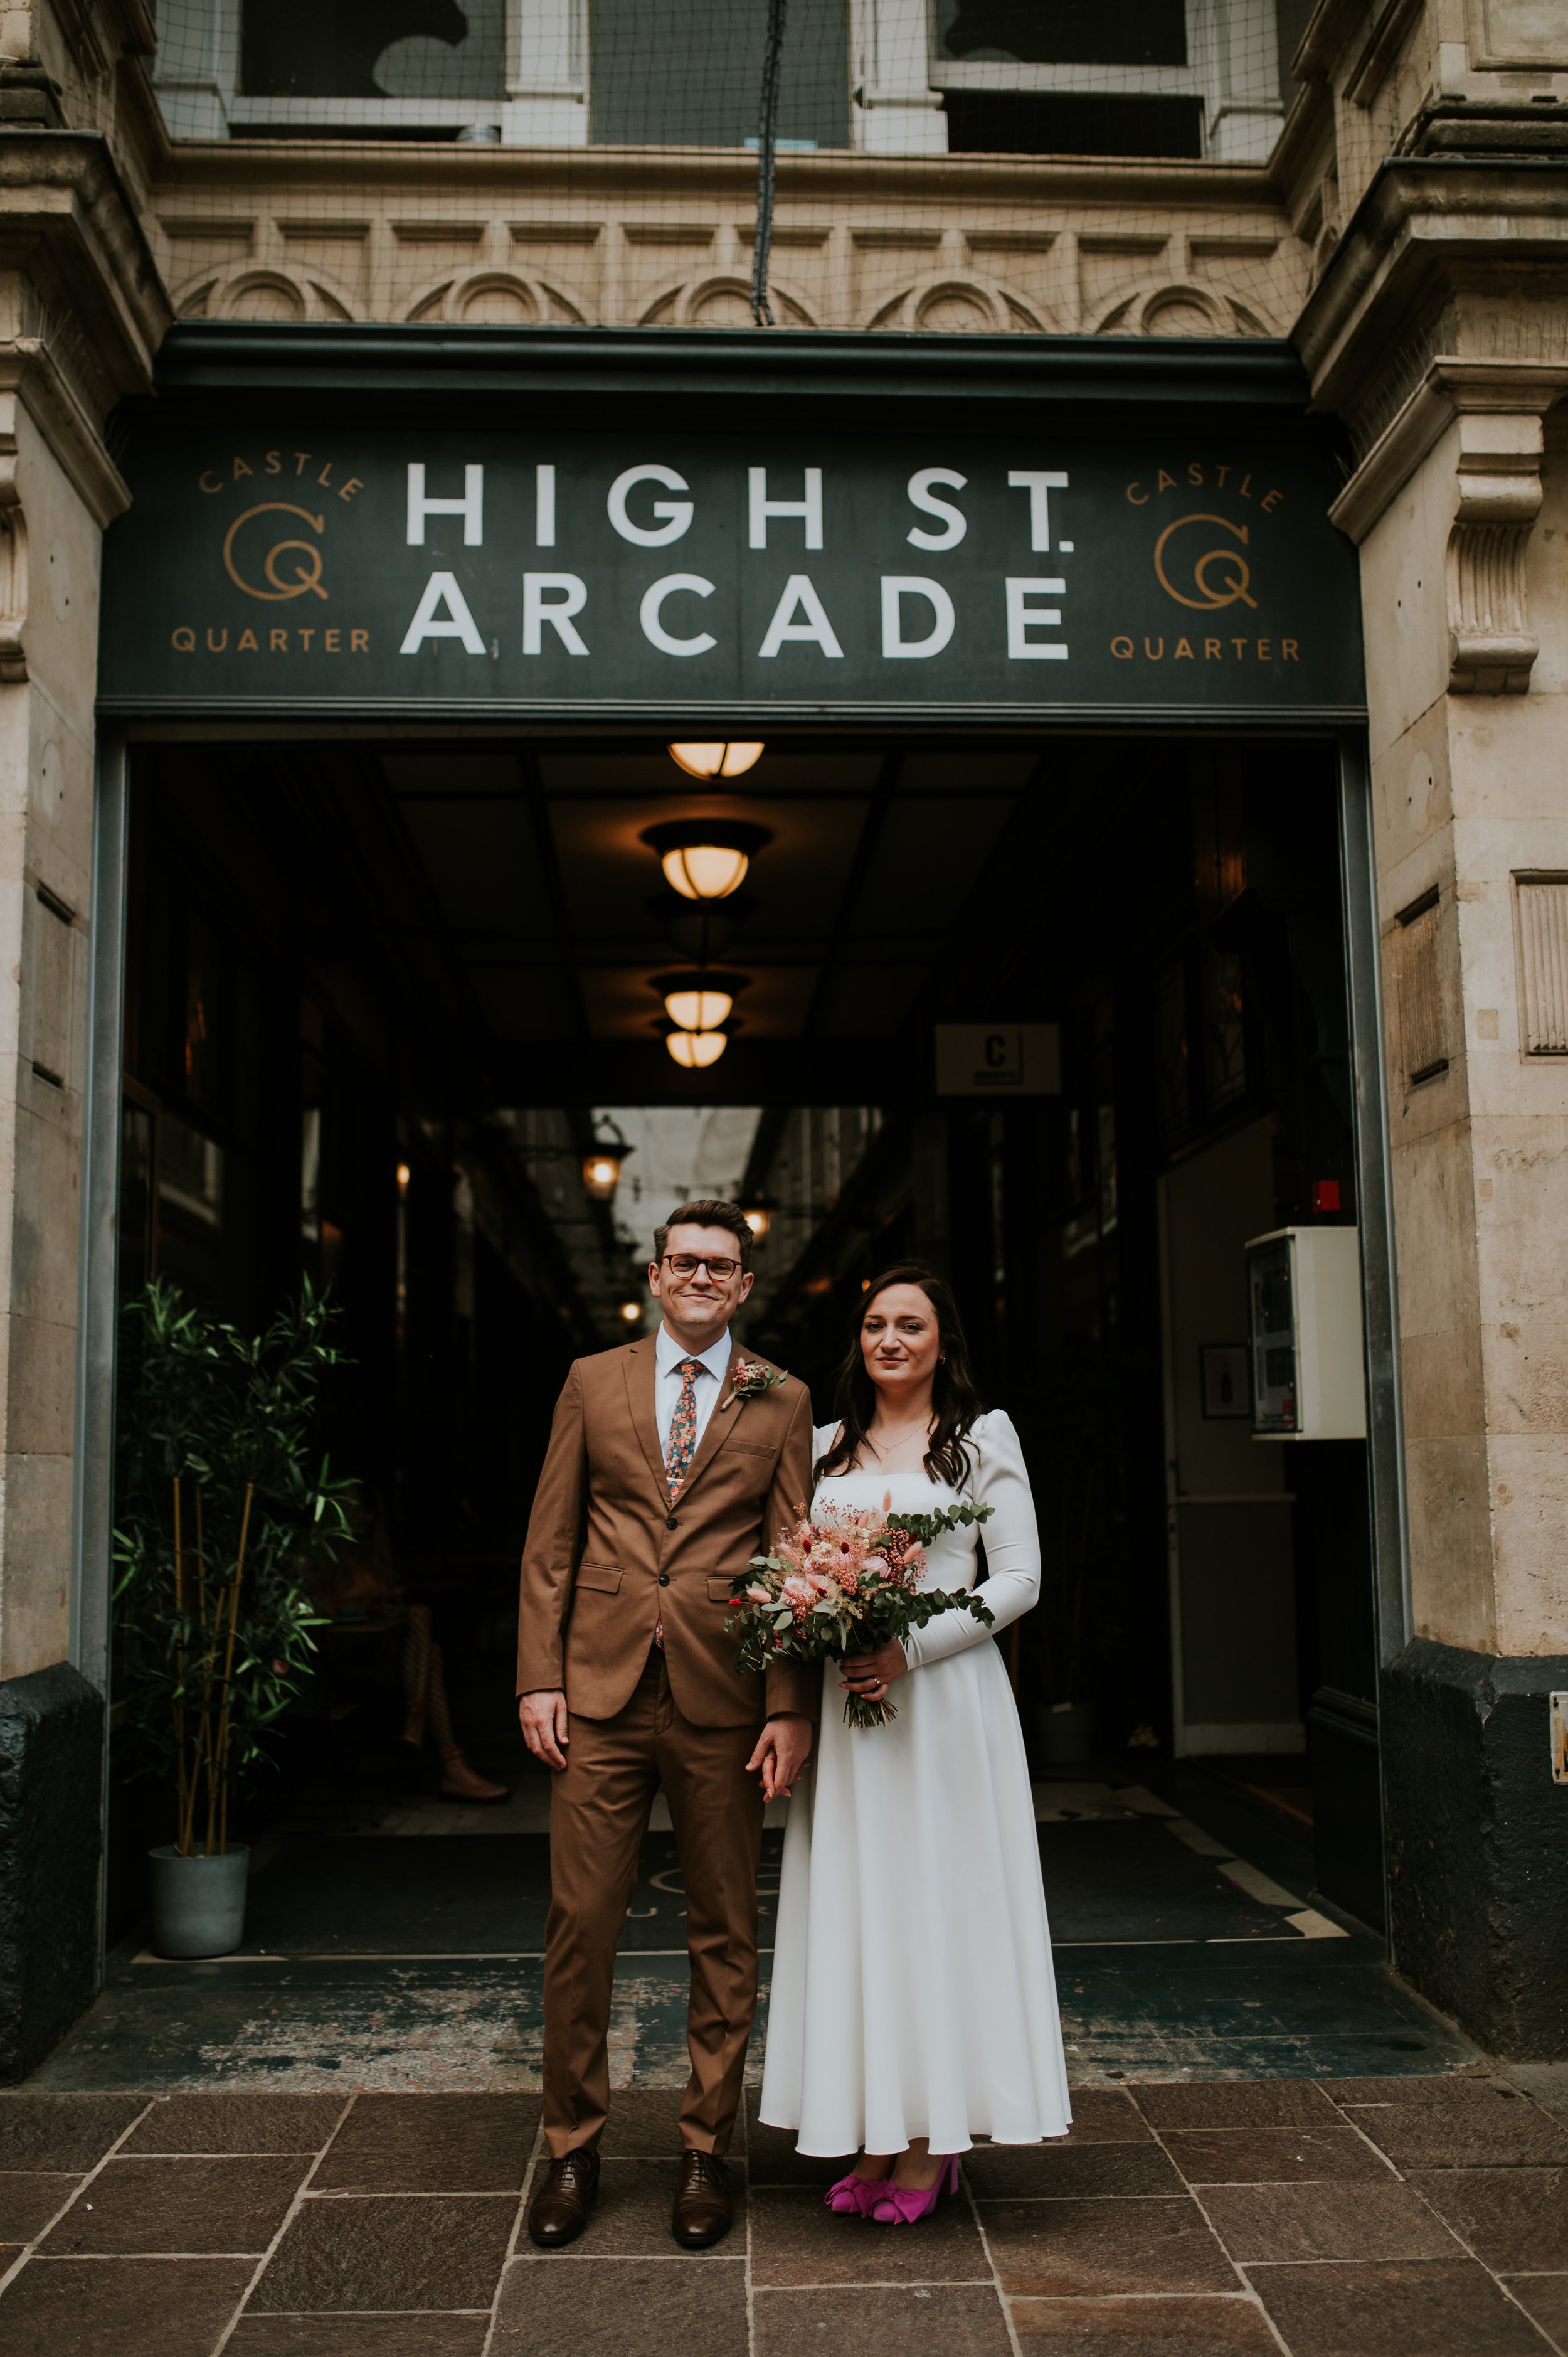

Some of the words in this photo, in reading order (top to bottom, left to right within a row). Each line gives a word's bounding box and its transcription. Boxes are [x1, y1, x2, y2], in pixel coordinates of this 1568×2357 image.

[198, 450, 364, 502] CASTLE
[1126, 462, 1284, 513] CASTLE
[406, 463, 824, 550] HIGH
[906, 467, 1074, 552] ST.
[171, 627, 370, 653] QUARTER
[399, 571, 1069, 660] ARCADE
[1110, 635, 1300, 662] QUARTER
